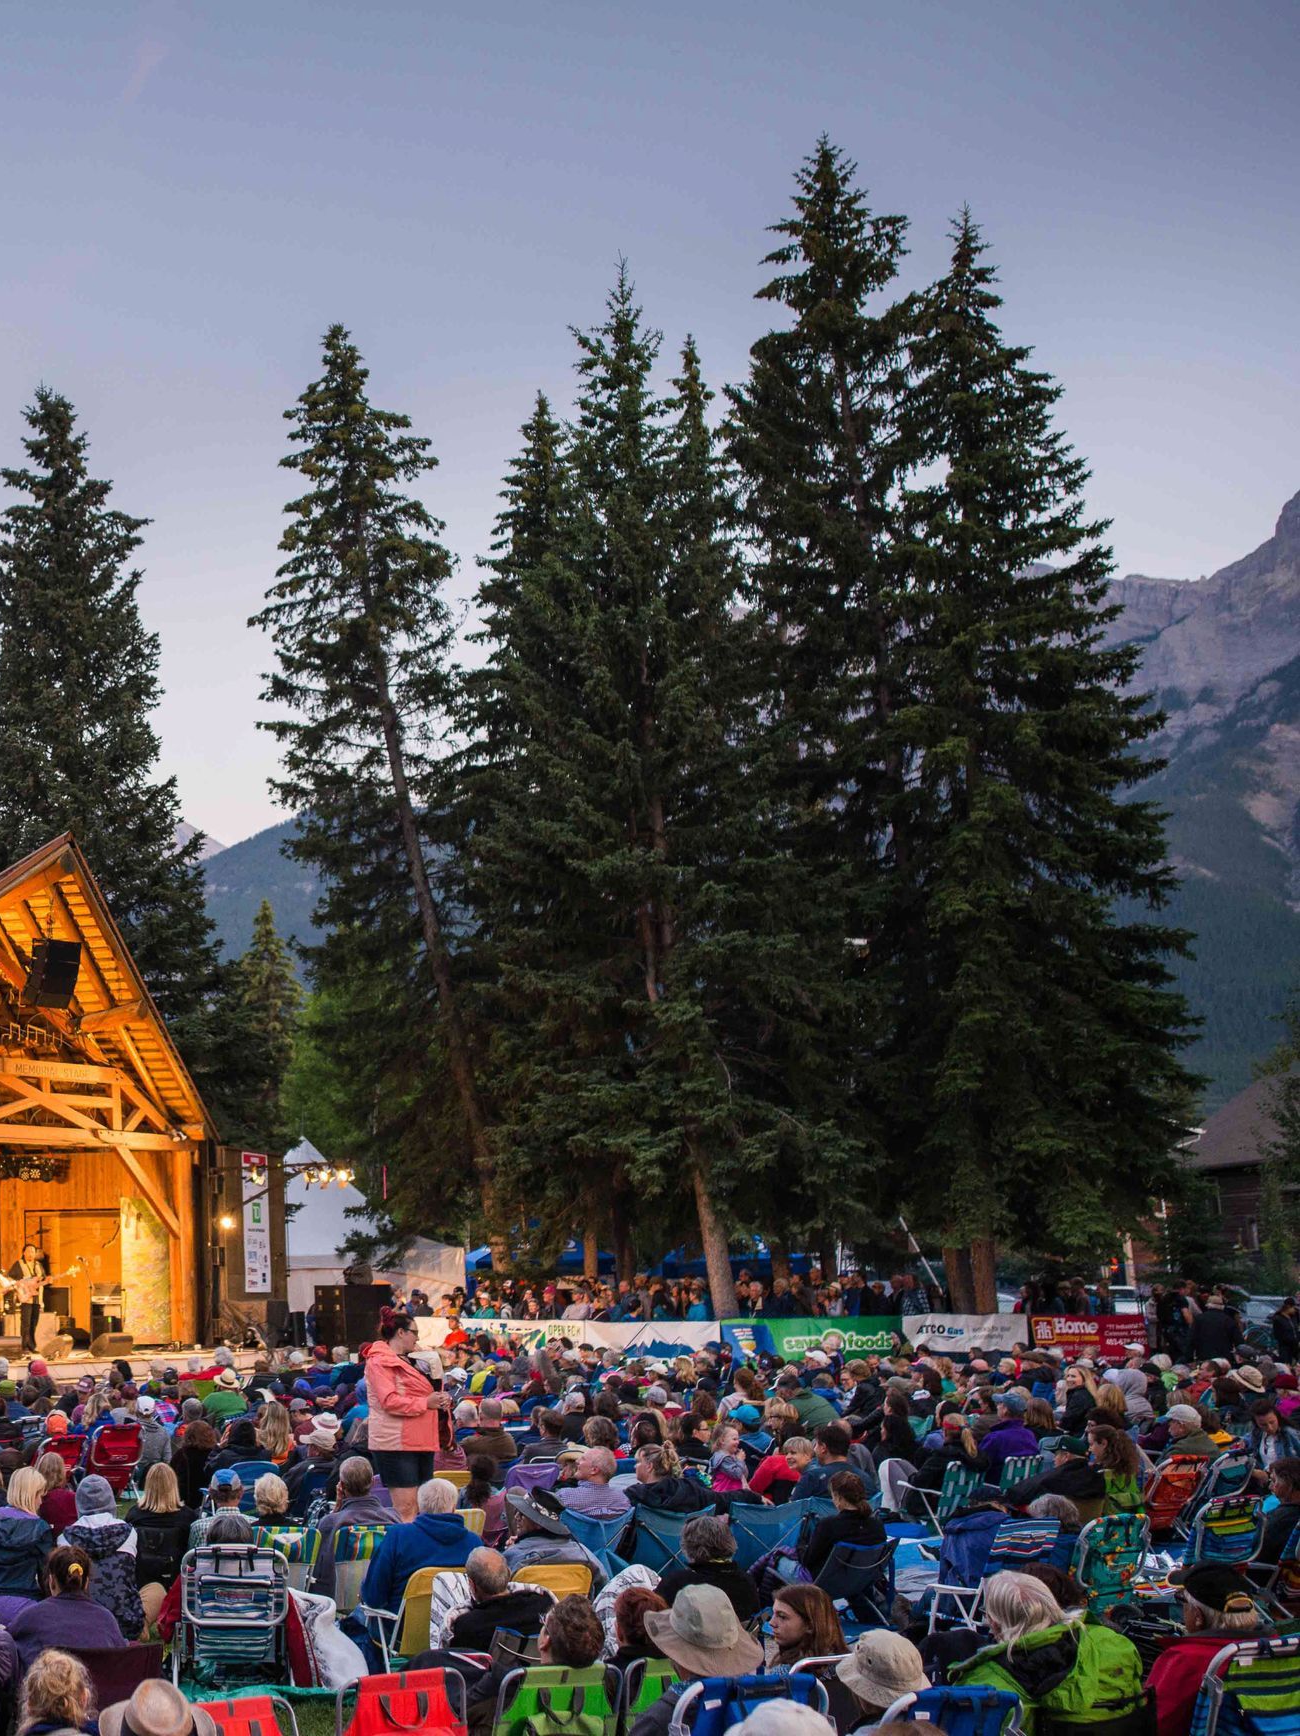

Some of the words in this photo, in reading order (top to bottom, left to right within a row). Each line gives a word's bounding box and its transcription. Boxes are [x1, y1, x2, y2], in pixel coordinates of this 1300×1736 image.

[15, 1063, 56, 1076] MEMORIAL
[548, 1325, 566, 1336] OPEN
[916, 1324, 945, 1335] ATCO
[947, 1327, 964, 1335] Gas
[1053, 1317, 1099, 1334] Home
[846, 1332, 894, 1350] foods
